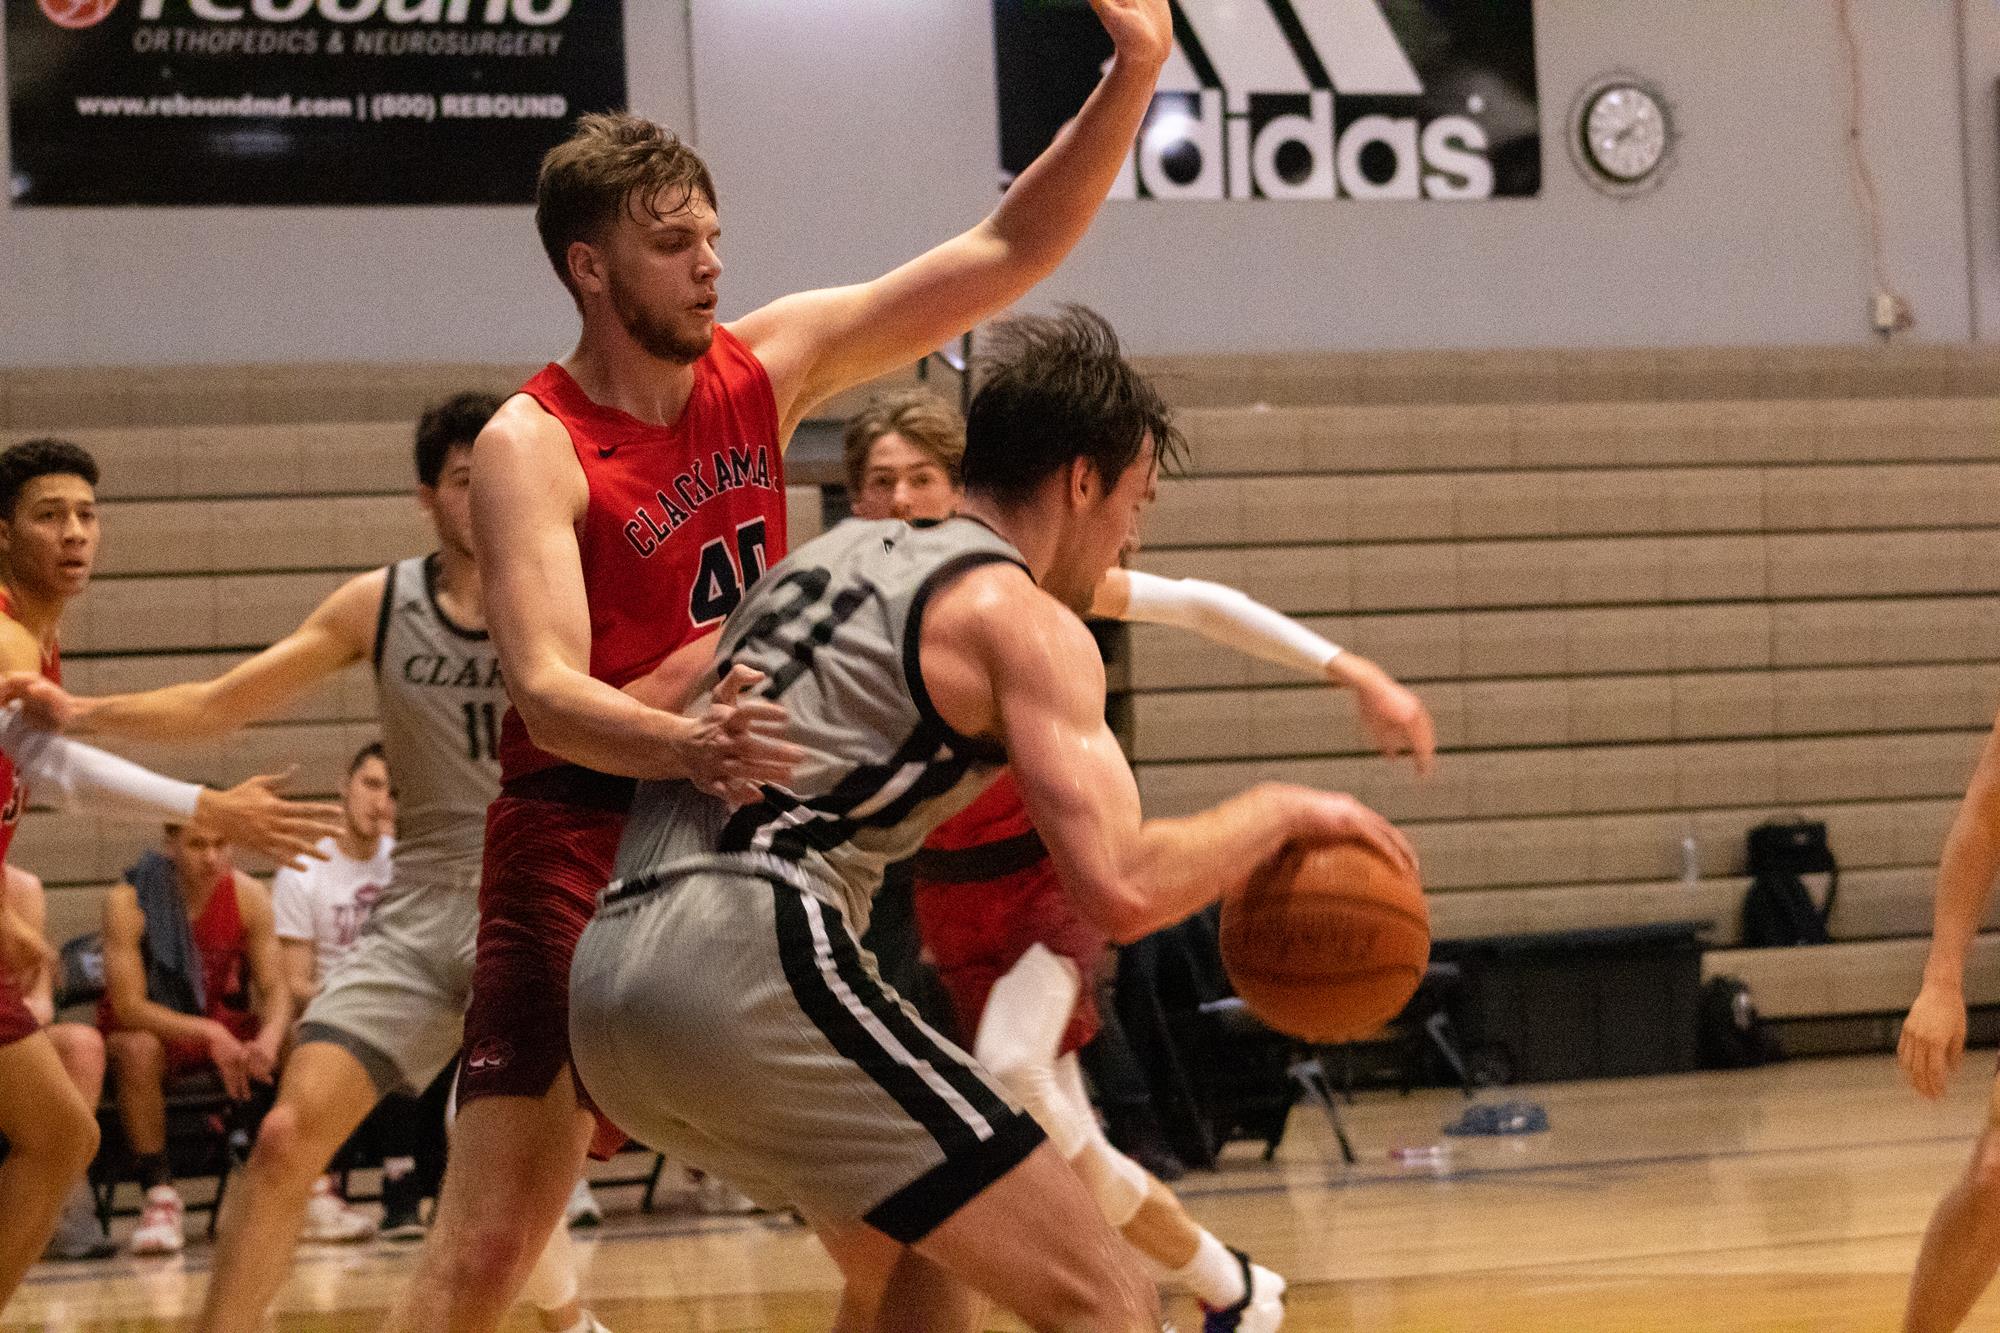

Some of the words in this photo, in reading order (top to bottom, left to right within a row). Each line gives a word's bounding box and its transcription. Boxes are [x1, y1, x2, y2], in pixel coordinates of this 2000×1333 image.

[132, 27, 318, 53] ORTHOPEDICS
[327, 29, 344, 54] &
[353, 29, 563, 56] NEUROSURGERY
[76, 92, 352, 118] www.reboundmd.com
[441, 94, 567, 118] REBOUND
[623, 443, 779, 559] CLACKAMA
[463, 702, 499, 761] 11
